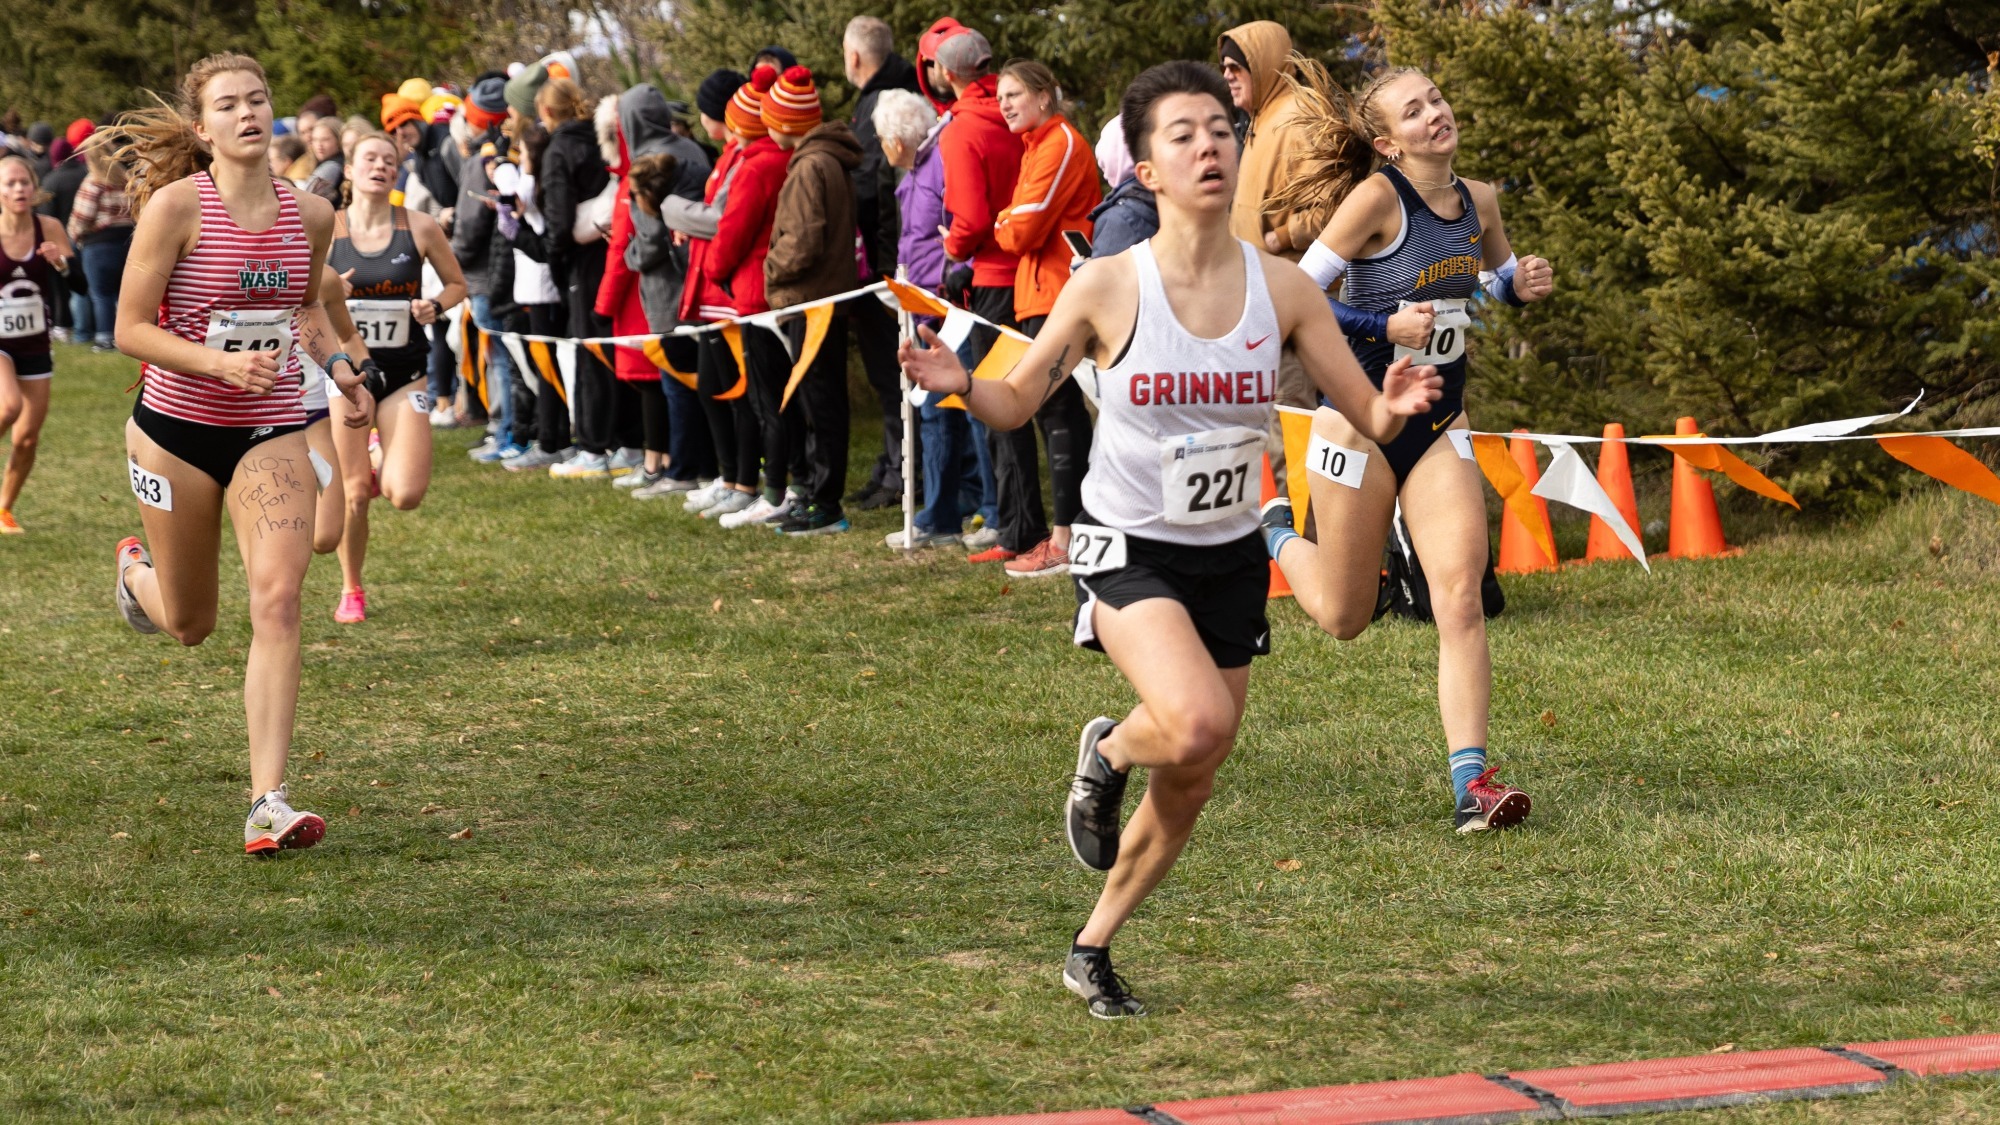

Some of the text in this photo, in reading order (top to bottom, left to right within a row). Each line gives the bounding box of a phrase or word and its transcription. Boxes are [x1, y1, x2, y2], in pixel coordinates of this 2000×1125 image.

[239, 271, 288, 288] WASH
[4, 313, 34, 332] 501
[355, 321, 398, 341] 517
[242, 457, 295, 479] NOT
[1321, 446, 1346, 477] 10
[132, 468, 162, 503] 543
[238, 471, 305, 510] For Me
[1187, 462, 1249, 513] 227
[258, 491, 291, 513] For
[251, 513, 310, 542] Them
[1070, 532, 1113, 567] 27
